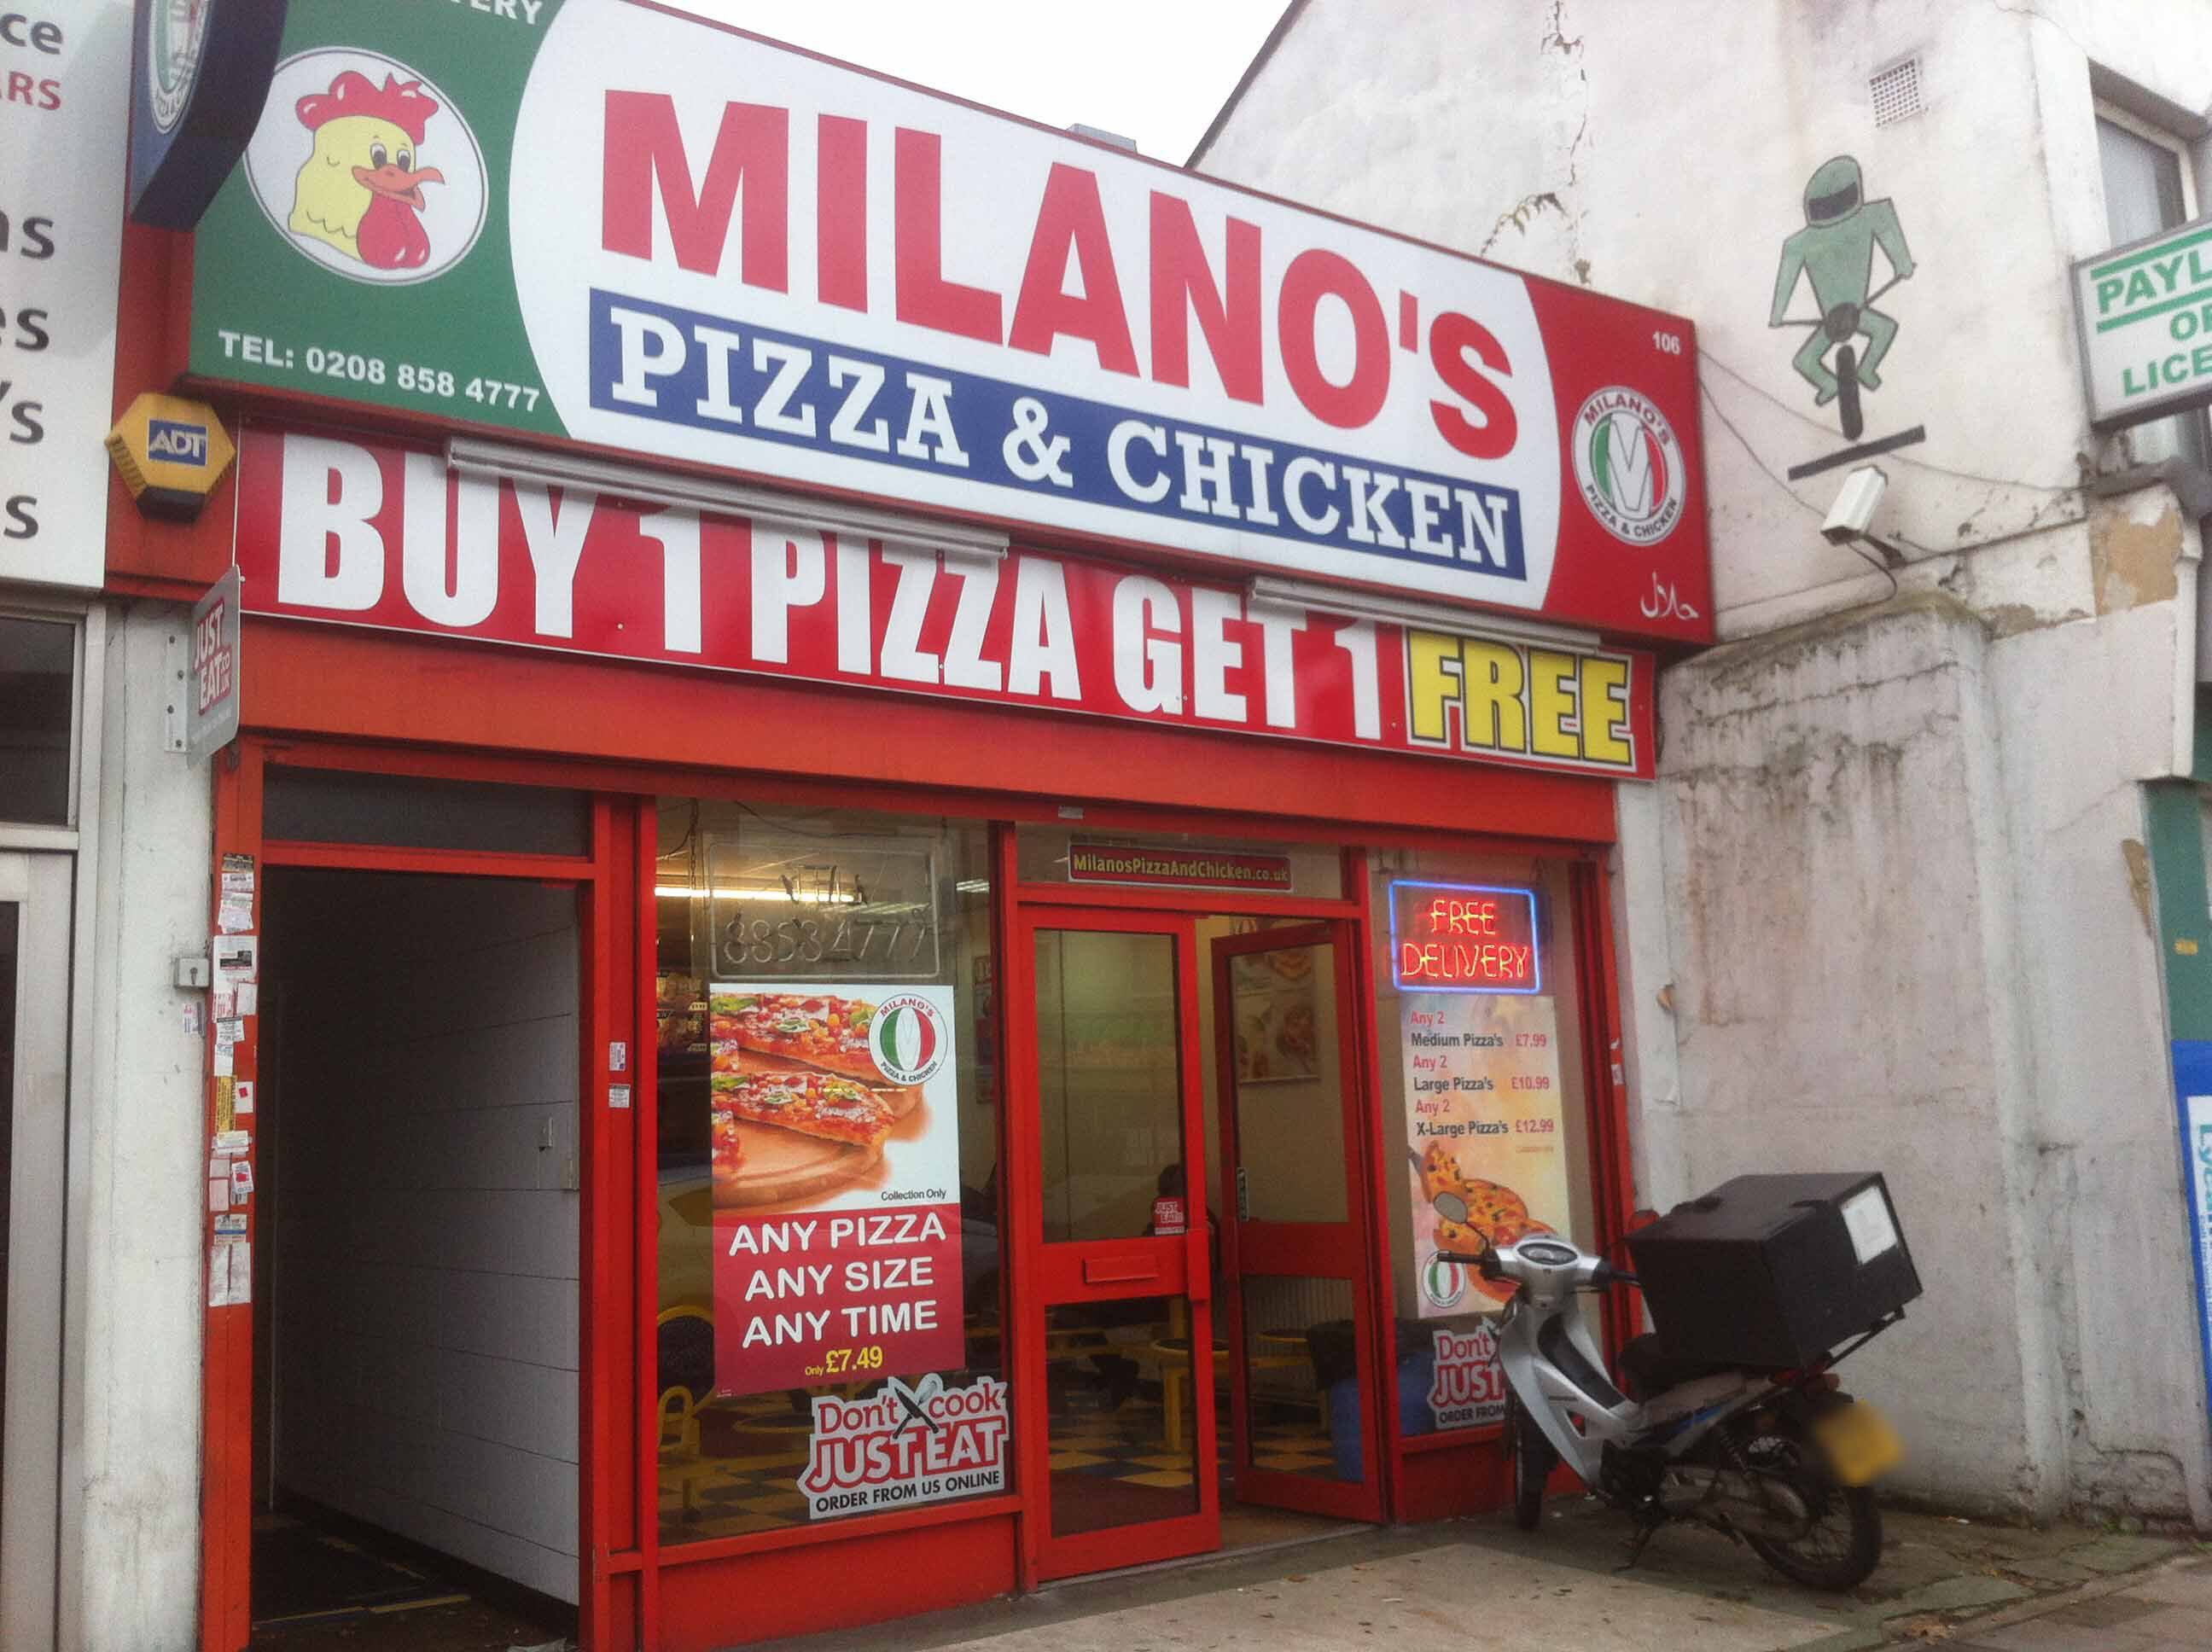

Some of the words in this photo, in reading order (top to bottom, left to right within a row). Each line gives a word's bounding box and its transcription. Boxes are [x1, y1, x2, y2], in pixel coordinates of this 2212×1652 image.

[0, 71, 61, 111] RS
[602, 89, 1518, 462] MILANO'S
[1652, 331, 1681, 355] 106
[218, 329, 294, 369] TEL:
[306, 346, 386, 384] 0208
[398, 364, 455, 397] 858
[465, 377, 540, 411] 4777
[609, 305, 970, 468] PIZZA
[1002, 398, 1074, 487] &
[1108, 419, 1510, 569] CHICKEN
[1583, 393, 1670, 446] MILANO'S
[149, 428, 207, 460] ADT
[1585, 484, 1617, 527] PIZZA
[1621, 522, 1631, 535] &
[1633, 497, 1678, 538] CHICKEN
[277, 432, 597, 639] BUY
[639, 506, 701, 654] 1
[750, 515, 1082, 701] PIZZA
[1112, 573, 1307, 729] GET
[1334, 618, 1382, 742] 1
[1406, 627, 1636, 770] FREE
[1639, 571, 1701, 620] حلال
[194, 602, 224, 669] JUST
[200, 655, 224, 711] EAT
[1073, 853, 1289, 881] MilanosPizzaAndChicken.co.uk
[1430, 899, 1497, 935] FREE
[1401, 942, 1528, 978] DELIVERY
[880, 998, 935, 1017] MILANO'S
[1411, 1010, 1434, 1028] Any
[1437, 1010, 1445, 1024] 2
[1411, 1032, 1460, 1047] Medium
[1464, 1032, 1504, 1047] Pizza's
[1515, 1033, 1547, 1048] £7.99
[881, 1061, 899, 1079] PIZZA
[908, 1061, 937, 1082] CHICKEN
[1413, 1055, 1436, 1072] Any
[1440, 1055, 1448, 1068] 2
[1414, 1077, 1450, 1095] Large
[1452, 1077, 1494, 1091] Pizza's
[1511, 1076, 1550, 1090] £10.99
[1415, 1098, 1439, 1117] Any
[1442, 1098, 1451, 1113] 2
[1417, 1121, 1465, 1138] X-Large
[1468, 1120, 1510, 1135] Pizza's
[1515, 1119, 1554, 1133] £12.99
[881, 1190, 925, 1201] Collection
[926, 1188, 946, 1200] Only
[729, 1219, 818, 1257] ANY
[830, 1212, 947, 1249] PIZZA
[744, 1264, 833, 1302] ANY
[845, 1256, 934, 1292] SIZE
[742, 1310, 831, 1349] ANY
[841, 1300, 938, 1338] TIME
[805, 1365, 824, 1376] Only
[825, 1346, 884, 1374] £7.49
[1437, 1331, 1492, 1361] Don't
[1435, 1363, 1505, 1406] JUST
[818, 1394, 899, 1434] Don't
[928, 1382, 1001, 1419] cook
[1440, 1408, 1473, 1423] ORDER
[810, 1432, 917, 1488] JUST
[926, 1420, 1003, 1470] EAT
[816, 1492, 868, 1513] ORDER
[873, 1484, 917, 1504] FROM
[922, 1479, 940, 1495] US
[946, 1470, 999, 1492] ONLINE
